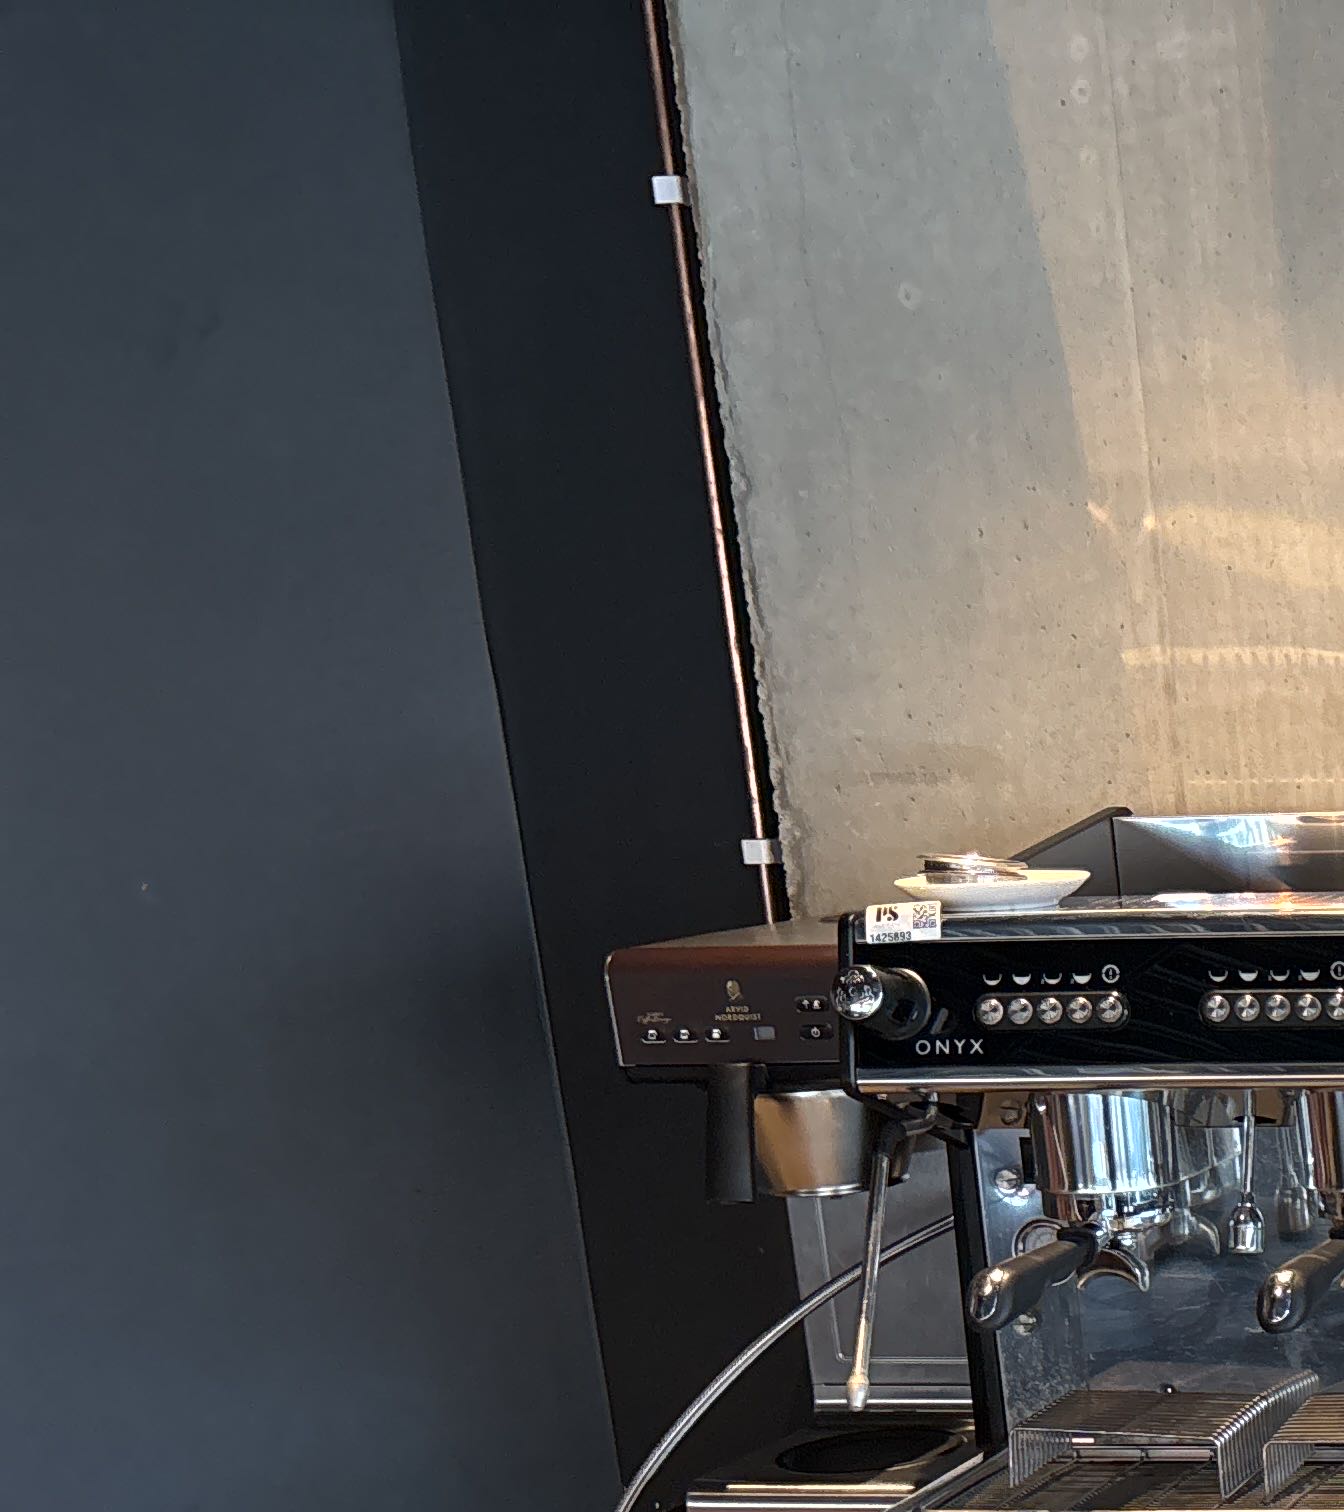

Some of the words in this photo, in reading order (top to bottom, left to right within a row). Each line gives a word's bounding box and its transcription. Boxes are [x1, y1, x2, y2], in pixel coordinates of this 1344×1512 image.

[876, 906, 899, 922] PS
[869, 931, 912, 943] 1425893
[915, 1038, 984, 1056] ONYX
